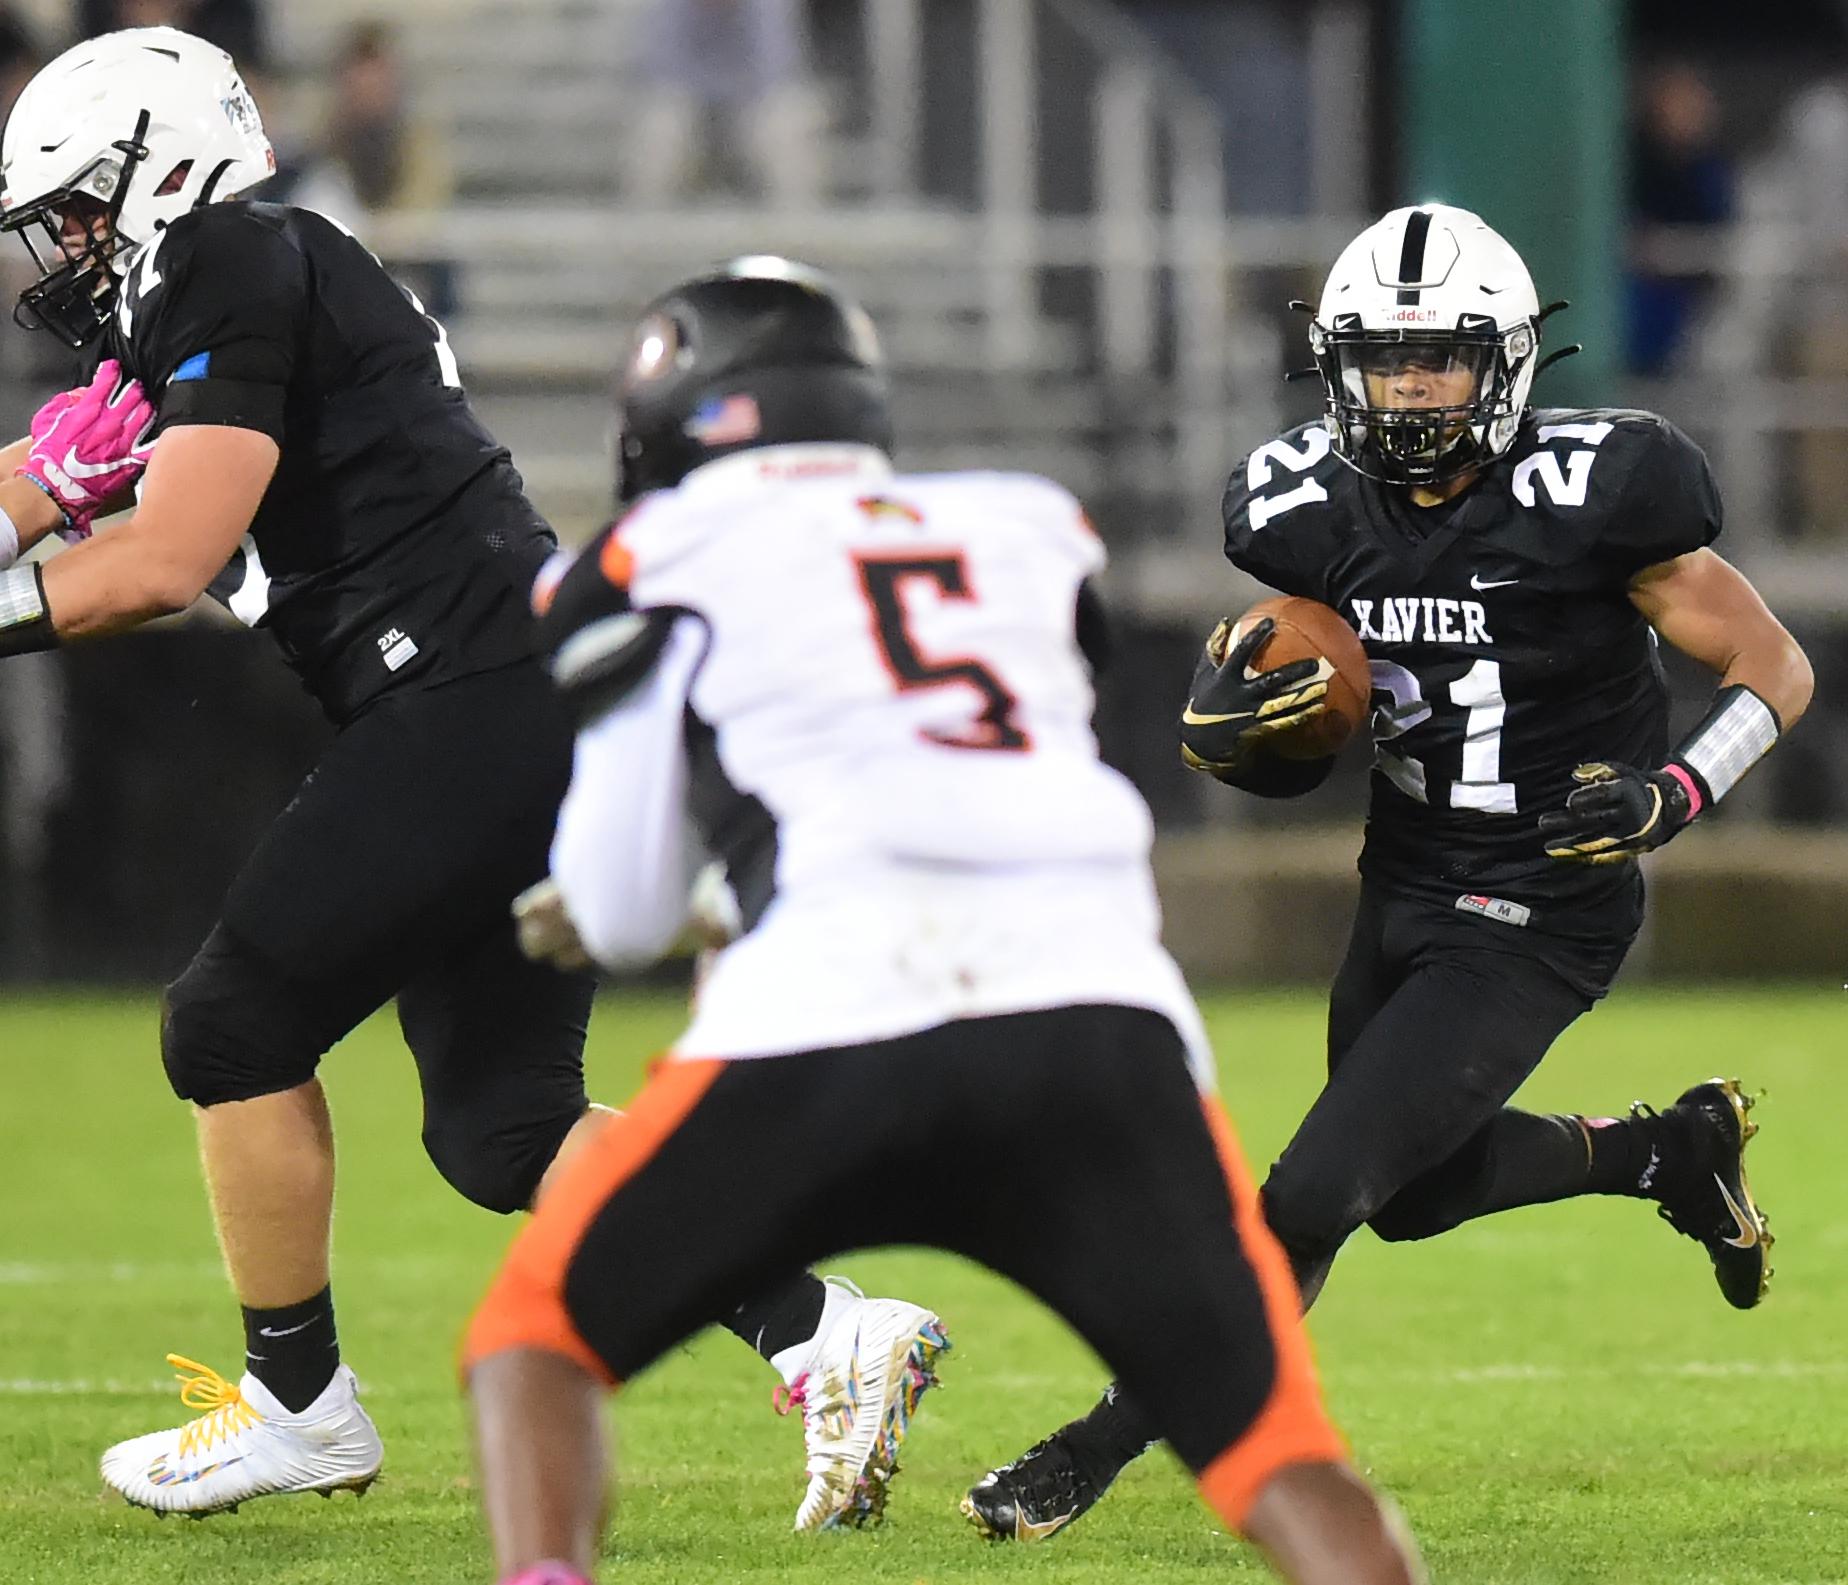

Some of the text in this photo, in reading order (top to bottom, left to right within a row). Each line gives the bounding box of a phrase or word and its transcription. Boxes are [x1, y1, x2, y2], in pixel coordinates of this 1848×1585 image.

[1247, 427, 1337, 531] 21
[1511, 422, 1614, 507] 21
[377, 627, 405, 652] 2XL
[847, 543, 1033, 754] 5
[1351, 597, 1494, 644] XAVIER
[1369, 659, 1519, 814] 21
[1497, 903, 1512, 918] M
